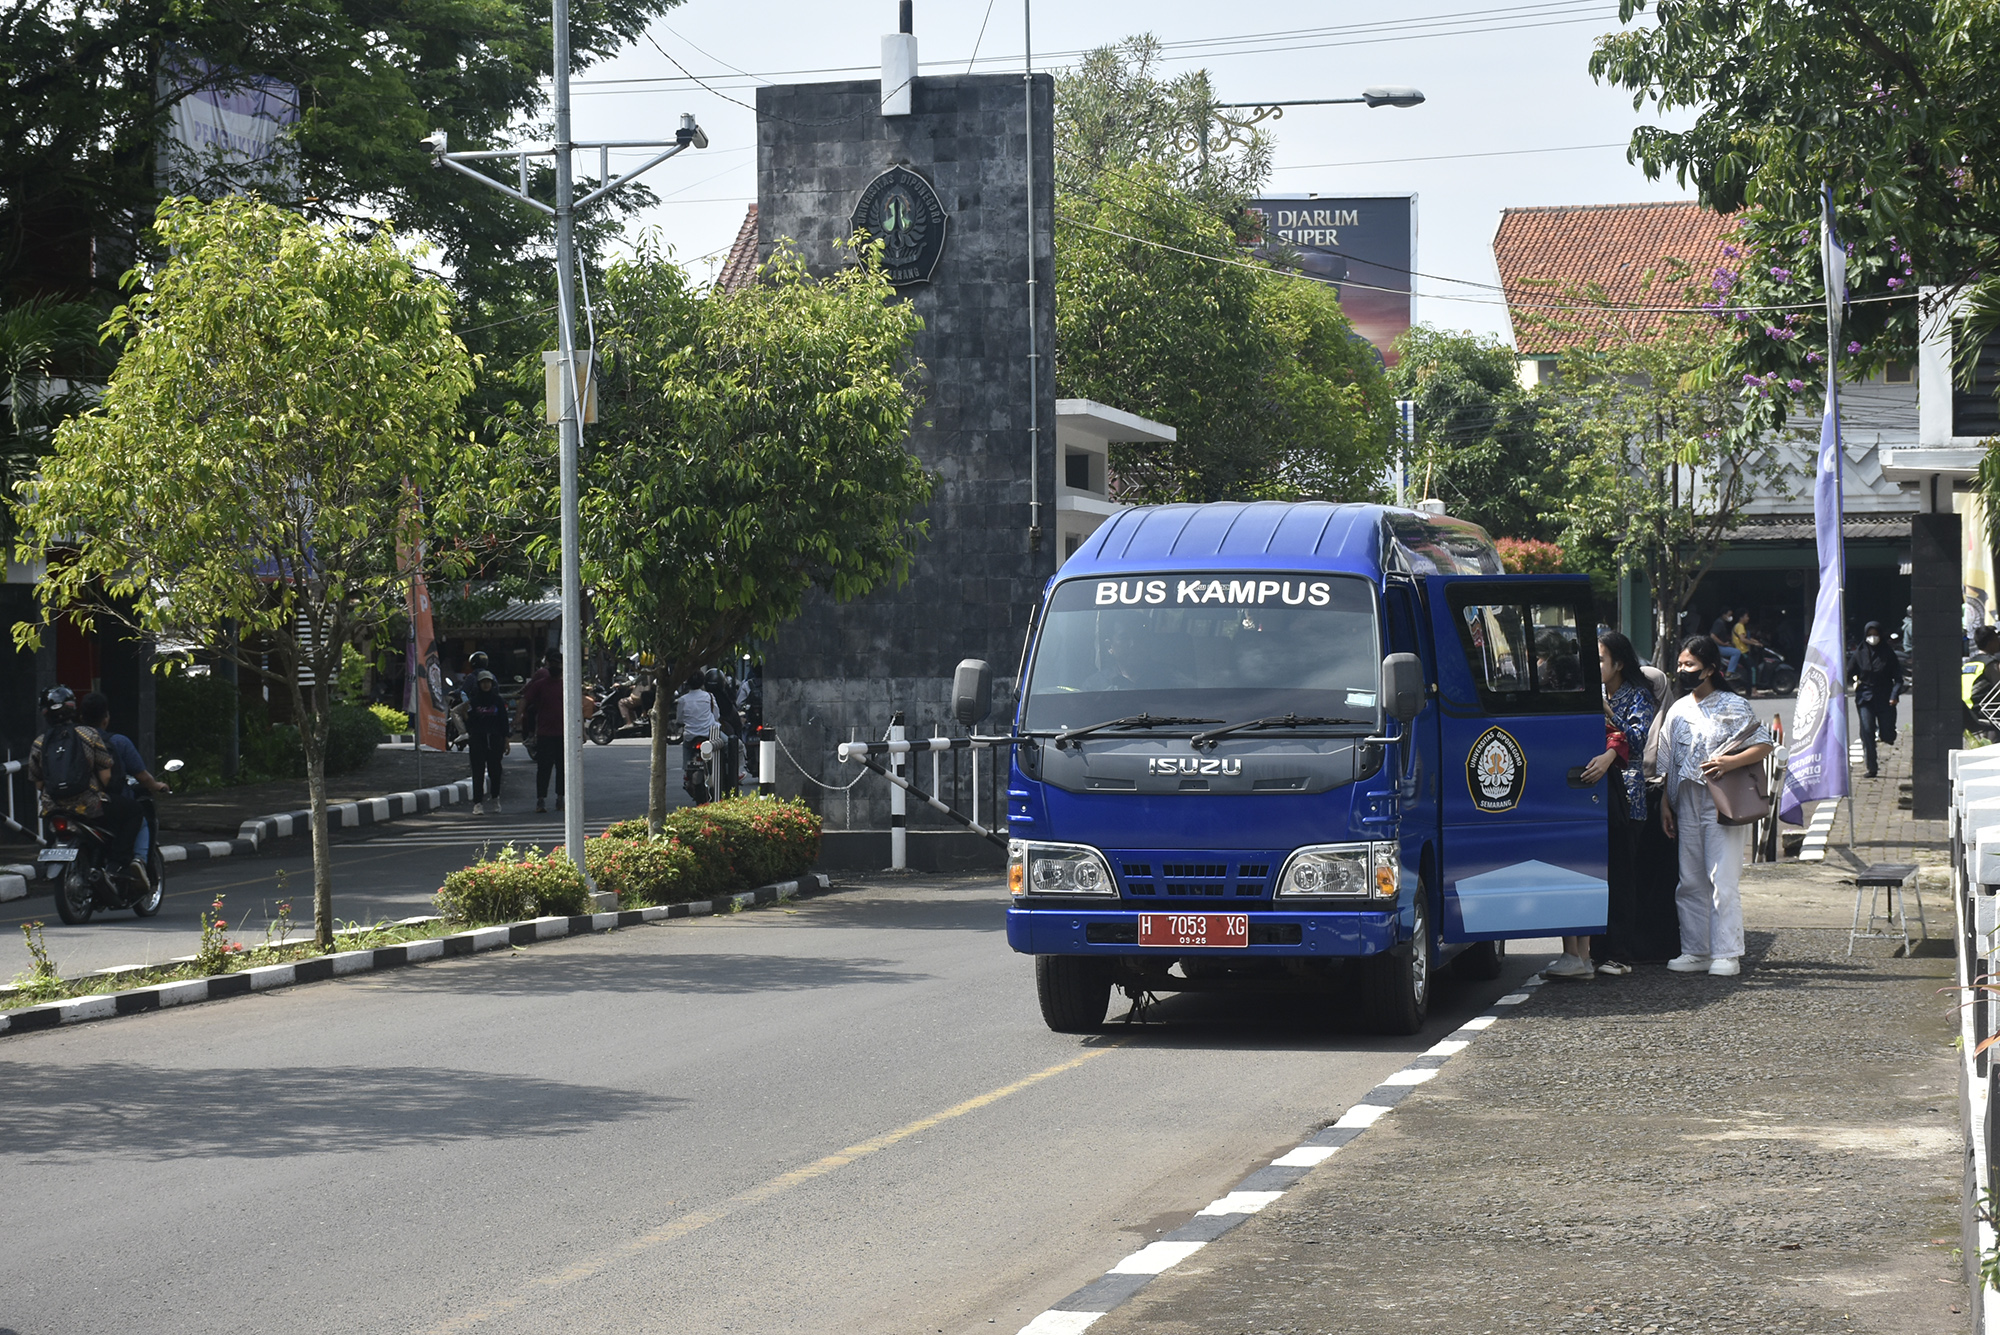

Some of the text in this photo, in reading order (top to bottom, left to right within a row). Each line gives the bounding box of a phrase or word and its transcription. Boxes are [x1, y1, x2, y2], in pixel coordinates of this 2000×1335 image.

[857, 174, 941, 224] UNIVERSITAS DIPONEGORO
[1277, 209, 1359, 228] DJARUM
[1277, 229, 1339, 246] SUPER
[1095, 580, 1331, 606] BUS KAMPUS
[1470, 731, 1523, 769] UNIVERSITAS DIPONEGORO
[1149, 758, 1242, 776] ISUZU
[1480, 799, 1512, 808] SEMARANG
[1141, 916, 1245, 935] H 7053 XG
